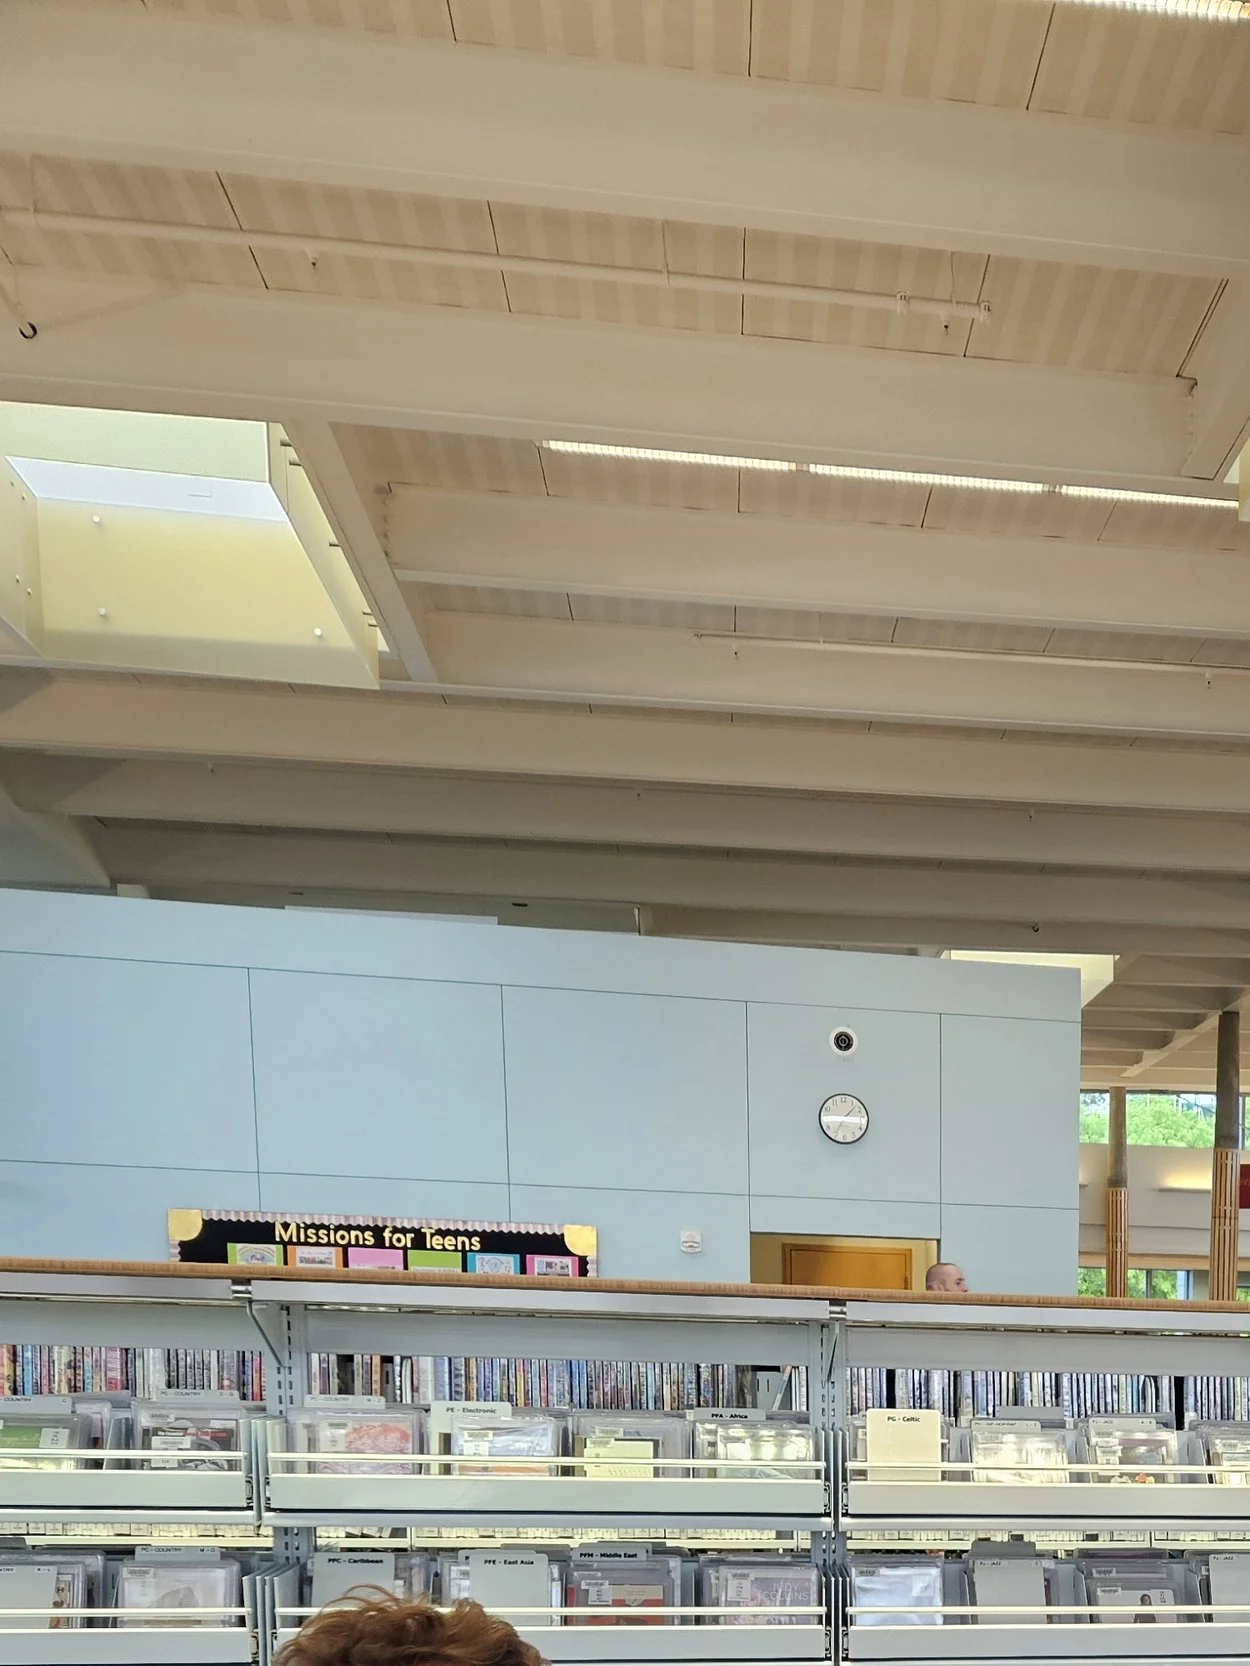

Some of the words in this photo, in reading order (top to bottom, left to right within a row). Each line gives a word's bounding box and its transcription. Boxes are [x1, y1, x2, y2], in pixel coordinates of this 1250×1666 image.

[274, 1221, 375, 1248] Missions
[383, 1227, 416, 1249] for
[421, 1228, 482, 1251] Teens
[902, 1415, 921, 1423] Celtic
[771, 1581, 799, 1592] JUDY
[762, 1590, 810, 1601] COLLINS
